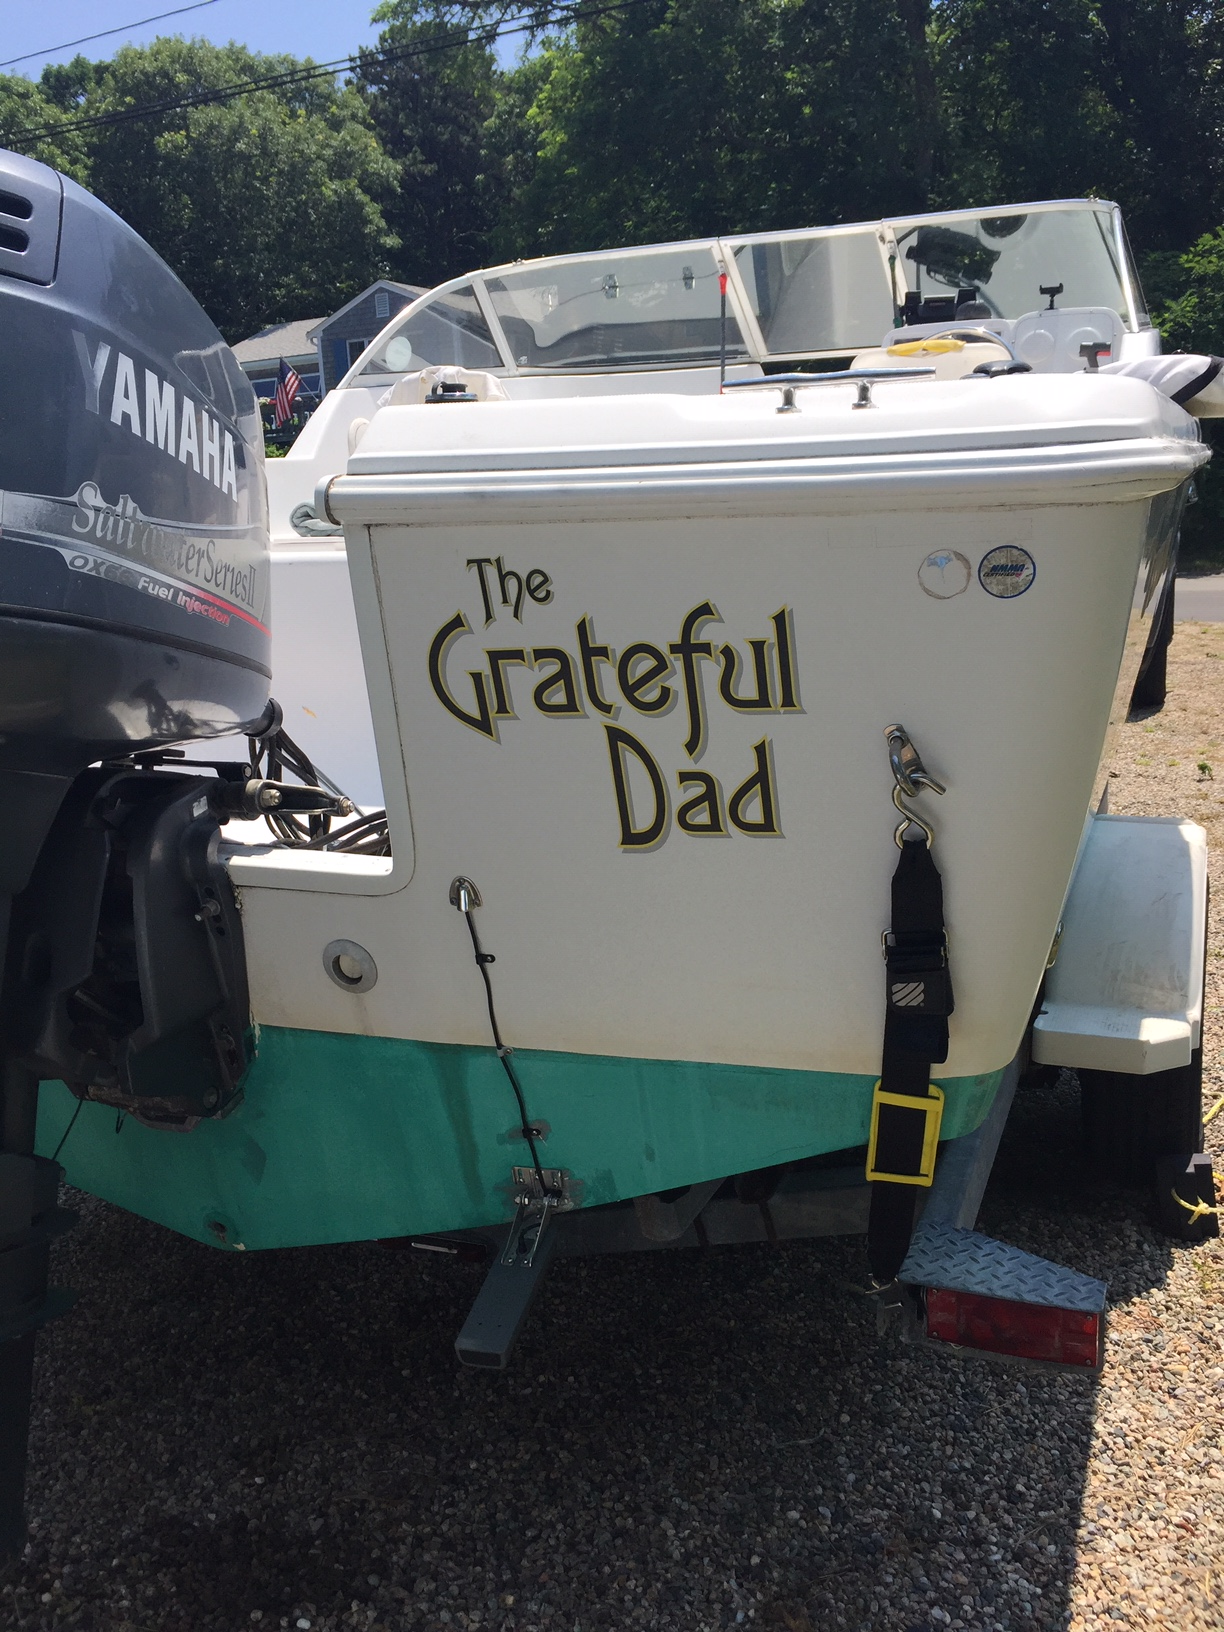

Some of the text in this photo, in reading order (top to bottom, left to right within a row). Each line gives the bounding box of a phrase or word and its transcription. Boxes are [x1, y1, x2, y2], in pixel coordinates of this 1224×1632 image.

[72, 329, 238, 503] YAMAHA
[137, 577, 174, 601] Fuel
[176, 591, 231, 626] Injection
[466, 555, 554, 629] The
[427, 599, 806, 764] Grateful
[601, 721, 786, 854] Dad
